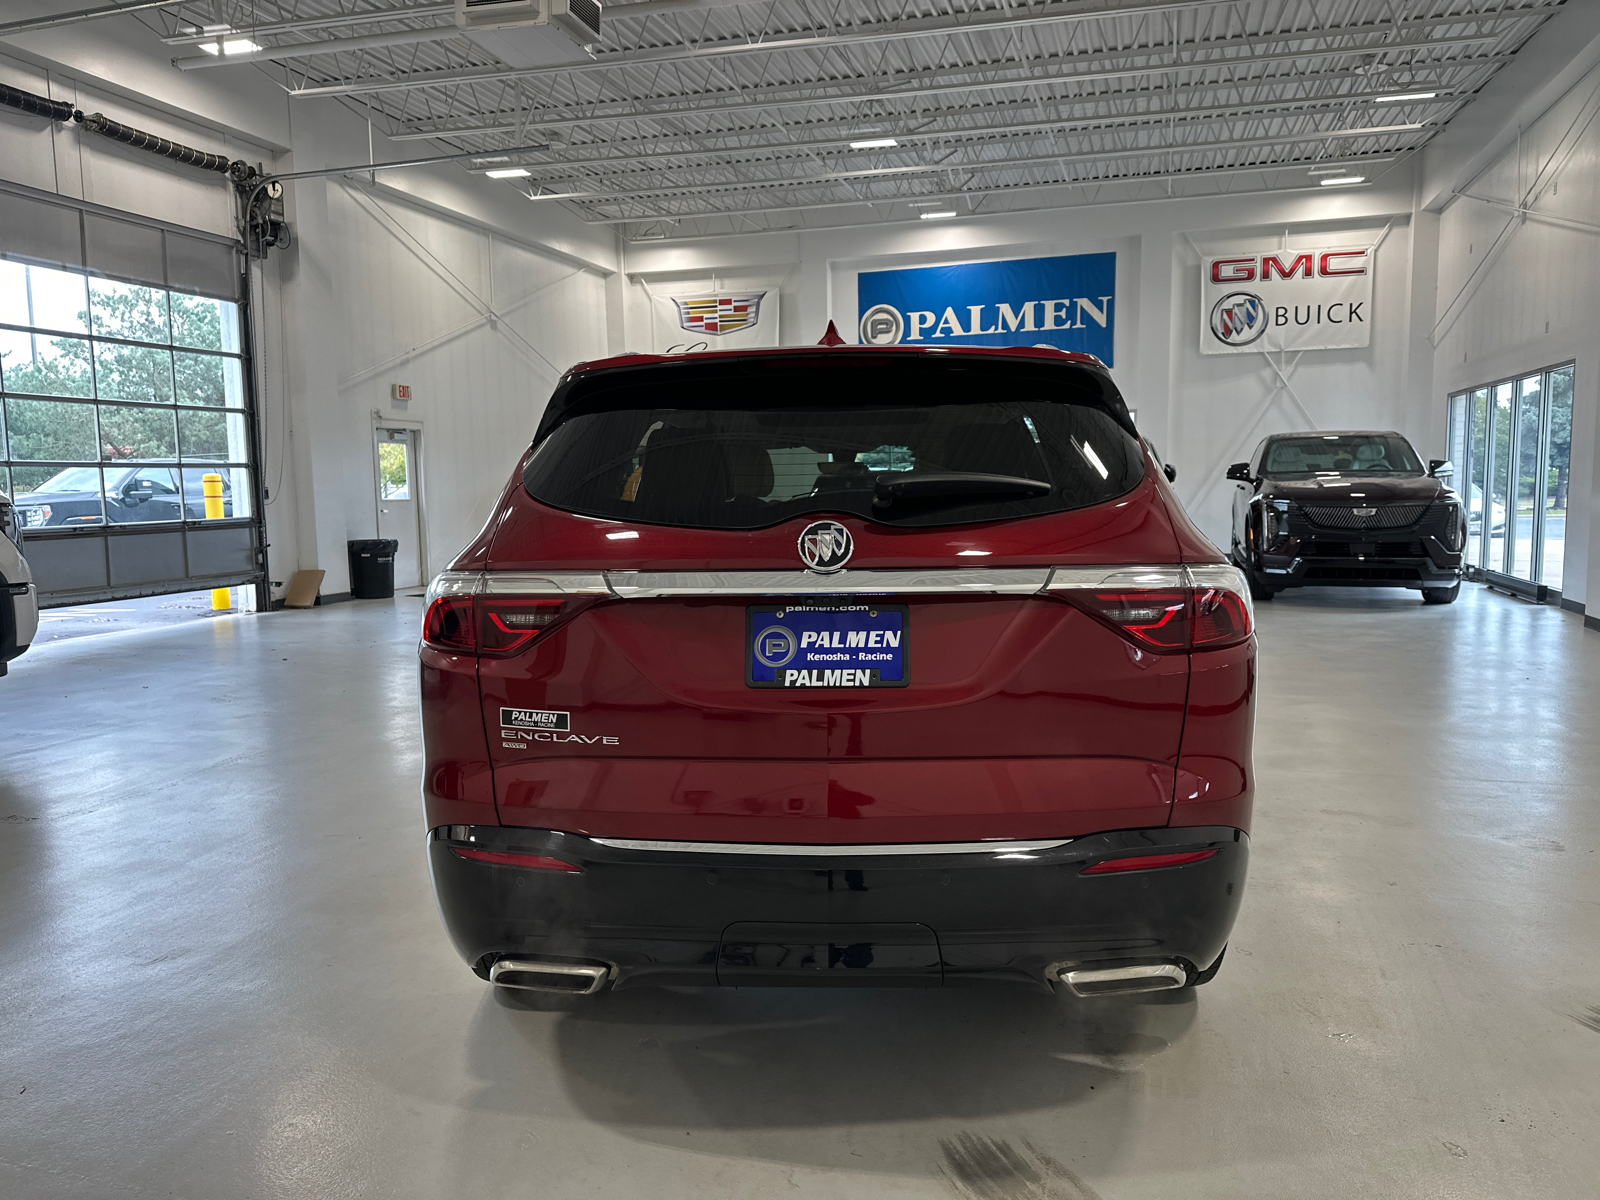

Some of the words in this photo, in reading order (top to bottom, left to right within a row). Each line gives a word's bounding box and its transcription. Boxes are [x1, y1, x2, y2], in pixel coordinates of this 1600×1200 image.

[1210, 249, 1368, 285] GMC
[906, 296, 1112, 341] PALMEN
[1275, 302, 1364, 326] BUICK
[398, 385, 410, 399] EXIT
[800, 630, 902, 648] PALMEN
[807, 652, 850, 661] Kenosha
[858, 652, 893, 661] Racine
[784, 669, 870, 687] PALMEN
[511, 711, 557, 723] PALMEN
[501, 730, 620, 745] ENCLAVE
